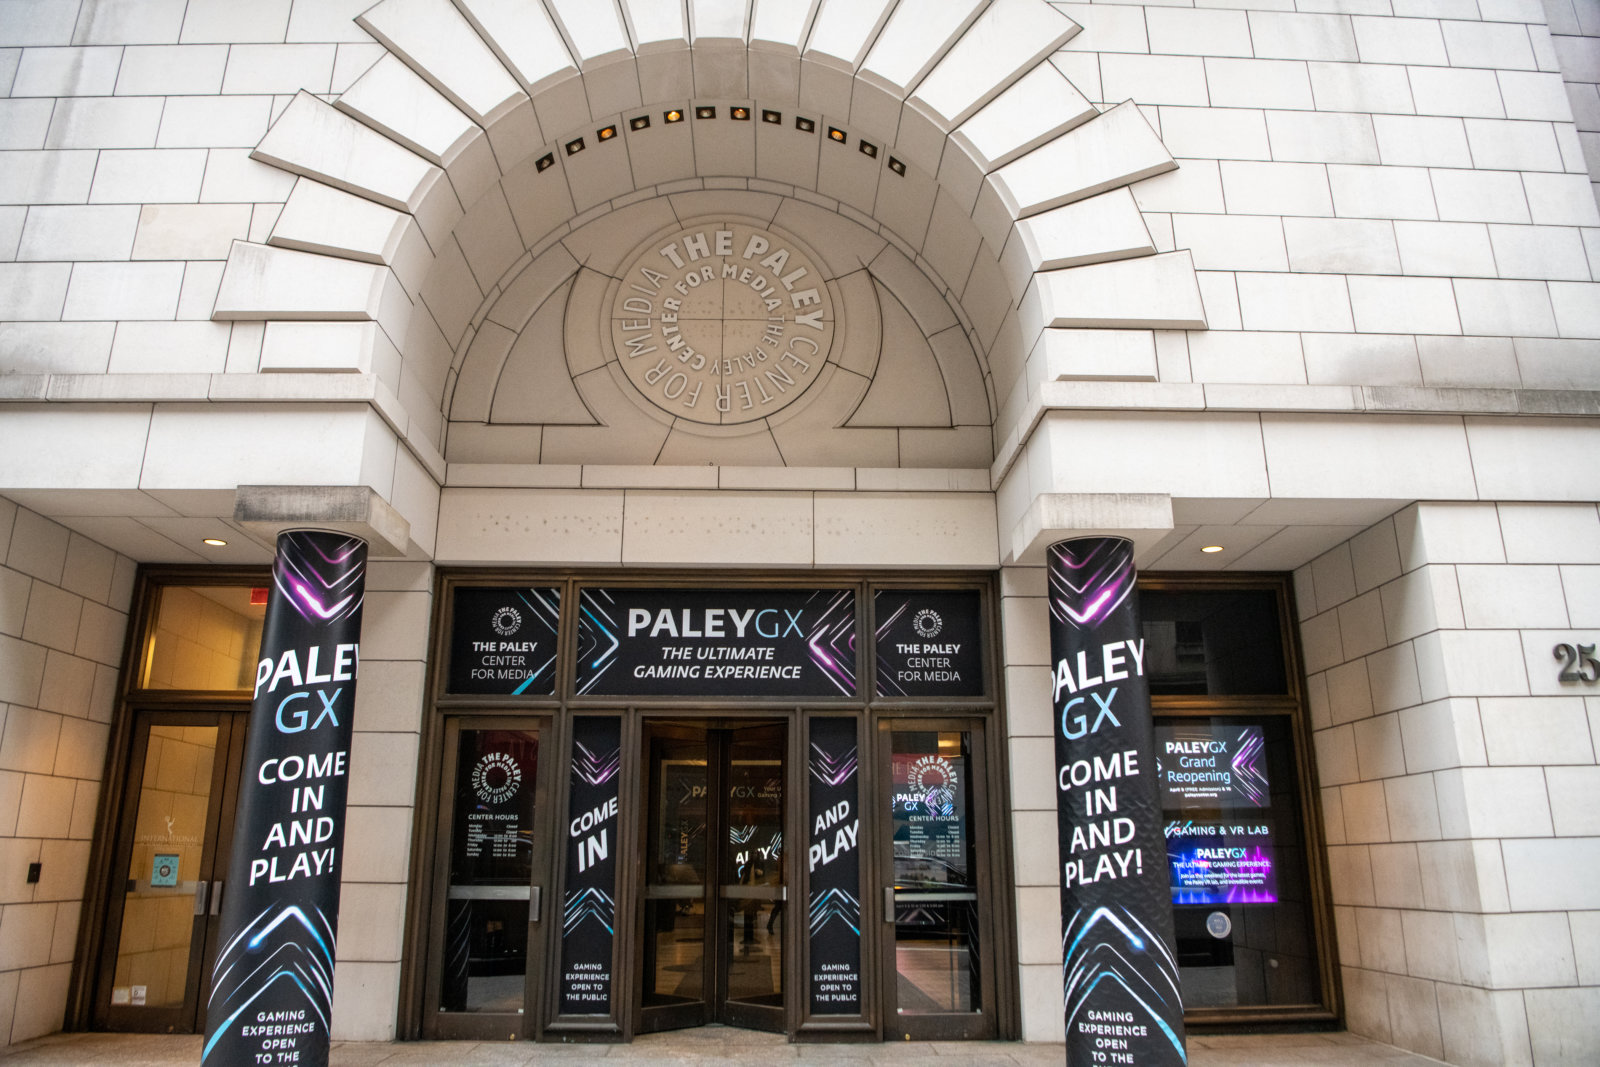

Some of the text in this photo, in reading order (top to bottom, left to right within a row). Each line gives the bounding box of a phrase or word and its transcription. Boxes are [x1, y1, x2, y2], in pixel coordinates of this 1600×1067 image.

[622, 230, 824, 413] THE PALEY CENTER FOR MEDIA
[661, 263, 785, 376] CENTER FOR MEDIA THE PALEY
[627, 608, 804, 638] PALEYGX
[472, 641, 538, 652] THE PALEY
[662, 647, 775, 660] THE ULTIMATE
[896, 644, 961, 655] THE PALEY
[481, 655, 526, 666] CENTER
[907, 657, 951, 668] CENTER
[1552, 643, 1600, 681] 25
[471, 668, 535, 680] FOR MEDIA
[633, 665, 802, 679] GAMING EXPERIENCE
[898, 671, 961, 682] FOR MEDIA
[1051, 638, 1145, 703] ALEY
[275, 688, 343, 734] GX
[1062, 687, 1122, 740] GX
[1165, 741, 1228, 754] PALEYGX
[258, 751, 347, 785] COME
[1179, 756, 1216, 768] Grand
[916, 755, 935, 768] THE
[936, 756, 958, 787] PALEY
[1059, 750, 1140, 791] COME
[1167, 770, 1231, 785] Reopening
[471, 752, 522, 804] THE PALEY CENTER FOR MEDIA
[291, 785, 325, 814] IN
[896, 793, 926, 802] PALEY
[1085, 786, 1118, 816] IN
[904, 802, 918, 811] GX
[570, 796, 618, 838] COME
[814, 800, 850, 835] AND
[262, 816, 334, 851] AND
[1070, 817, 1136, 854] AND
[1174, 826, 1269, 836] GAMING & VR LAB
[578, 828, 608, 873] IN
[809, 819, 859, 873] PLAY
[1197, 848, 1247, 859] PALEYGX
[249, 847, 335, 887] PLAY!
[1065, 848, 1143, 888] PLAY!
[565, 973, 610, 981] EXPERIENCE
[814, 973, 858, 981] EXPERIENCE
[571, 983, 603, 991] OPEN TO
[565, 993, 608, 1001] THE PUBLIC
[257, 1010, 306, 1022] GAMING
[1087, 1010, 1134, 1022] GAMING
[241, 1022, 315, 1037] EXPERIENCE
[1078, 1022, 1148, 1037] EXPERIENCE
[262, 1038, 297, 1050] OPEN
[1095, 1038, 1128, 1050] OPEN
[255, 1051, 300, 1064] TO THE
[1091, 1051, 1134, 1064] TO THE
